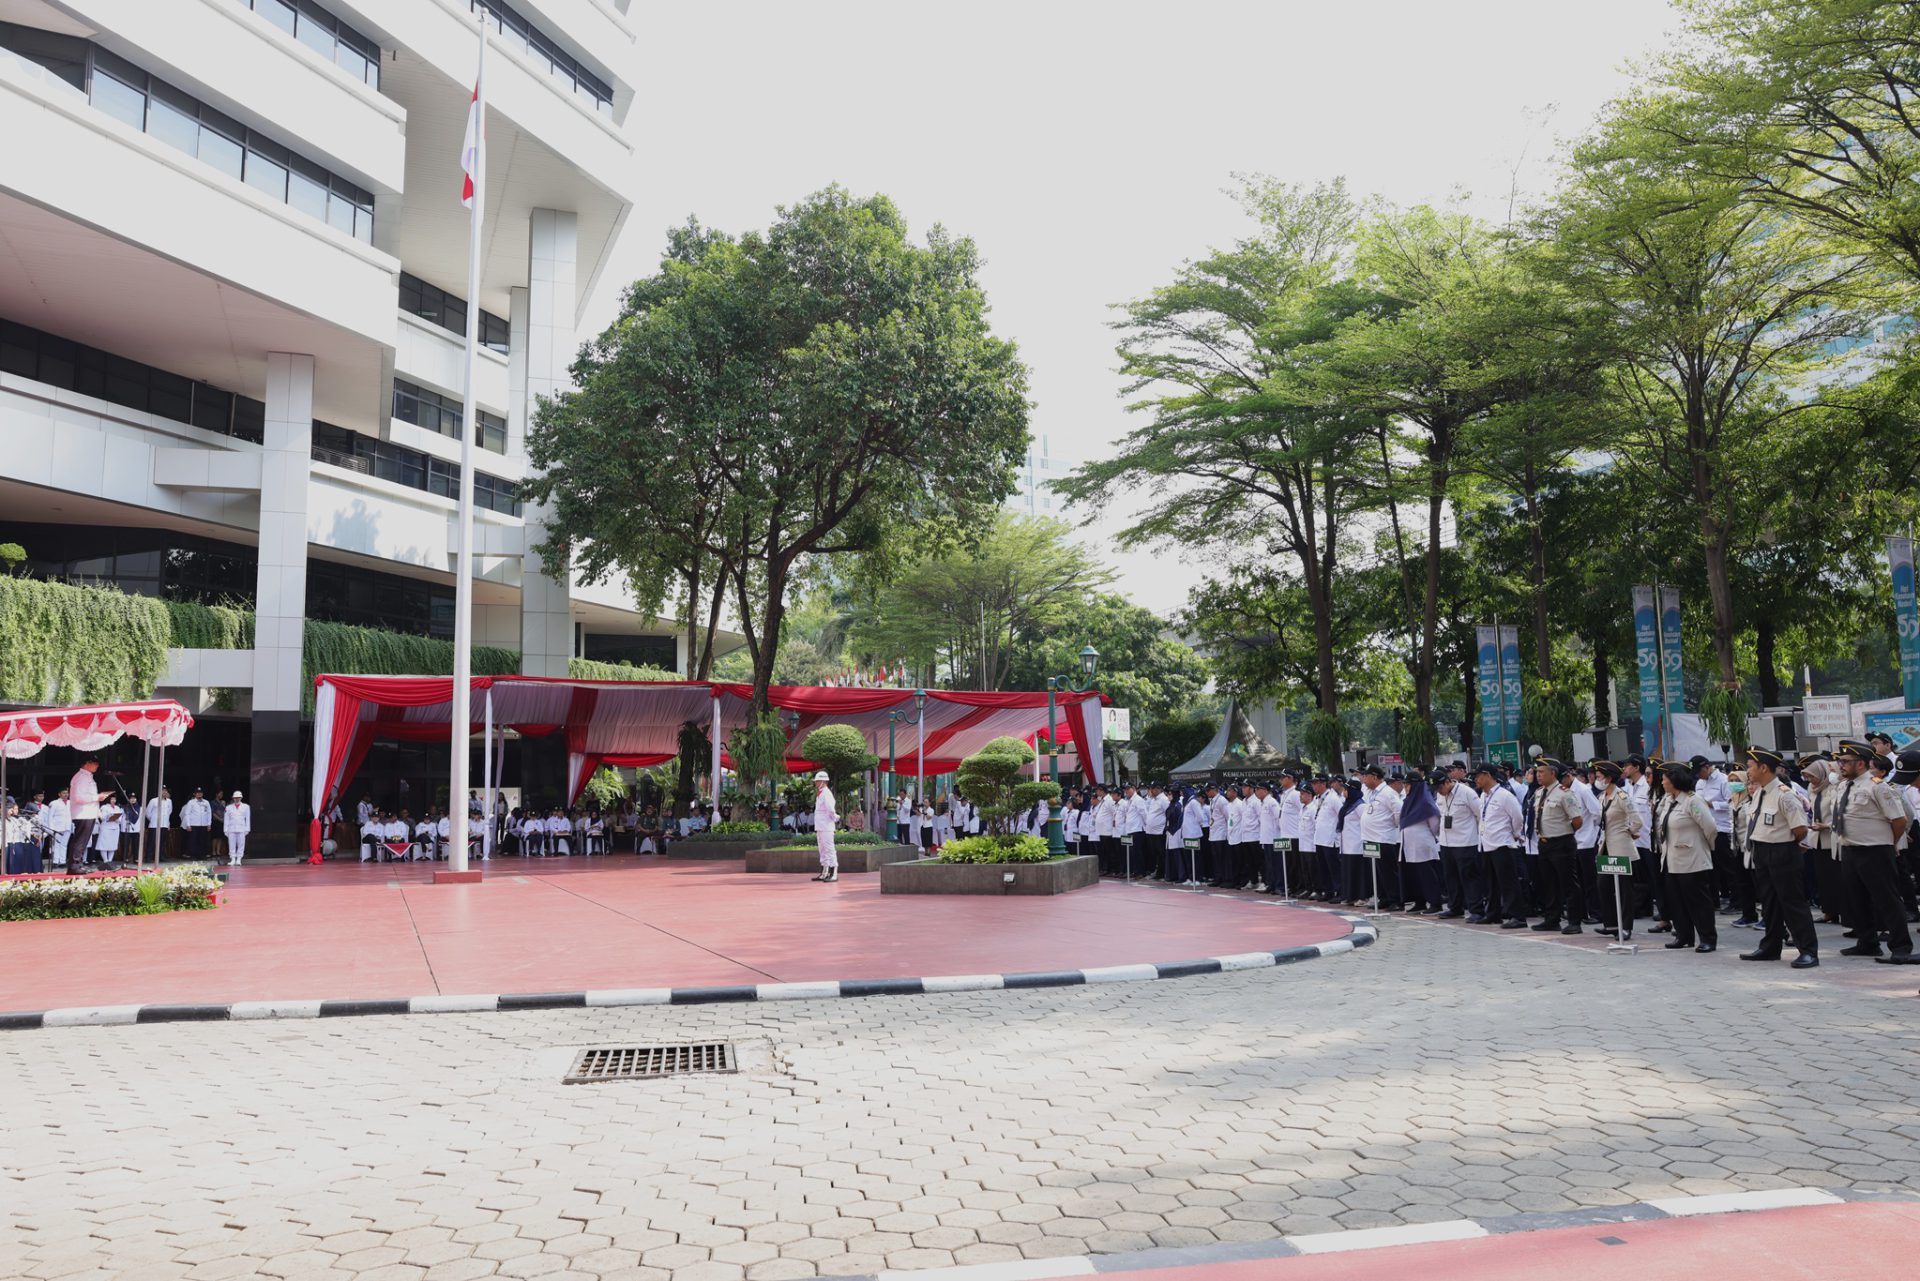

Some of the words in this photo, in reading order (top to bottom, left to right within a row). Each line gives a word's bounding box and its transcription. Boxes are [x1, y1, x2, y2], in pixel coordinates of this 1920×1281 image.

[1898, 613, 1919, 640] 59
[1638, 648, 1658, 672] 59
[1481, 680, 1500, 699] 59
[1503, 679, 1521, 698] 59
[1222, 770, 1266, 778] KEMENTERIAN
[1267, 769, 1304, 777] KESAN
